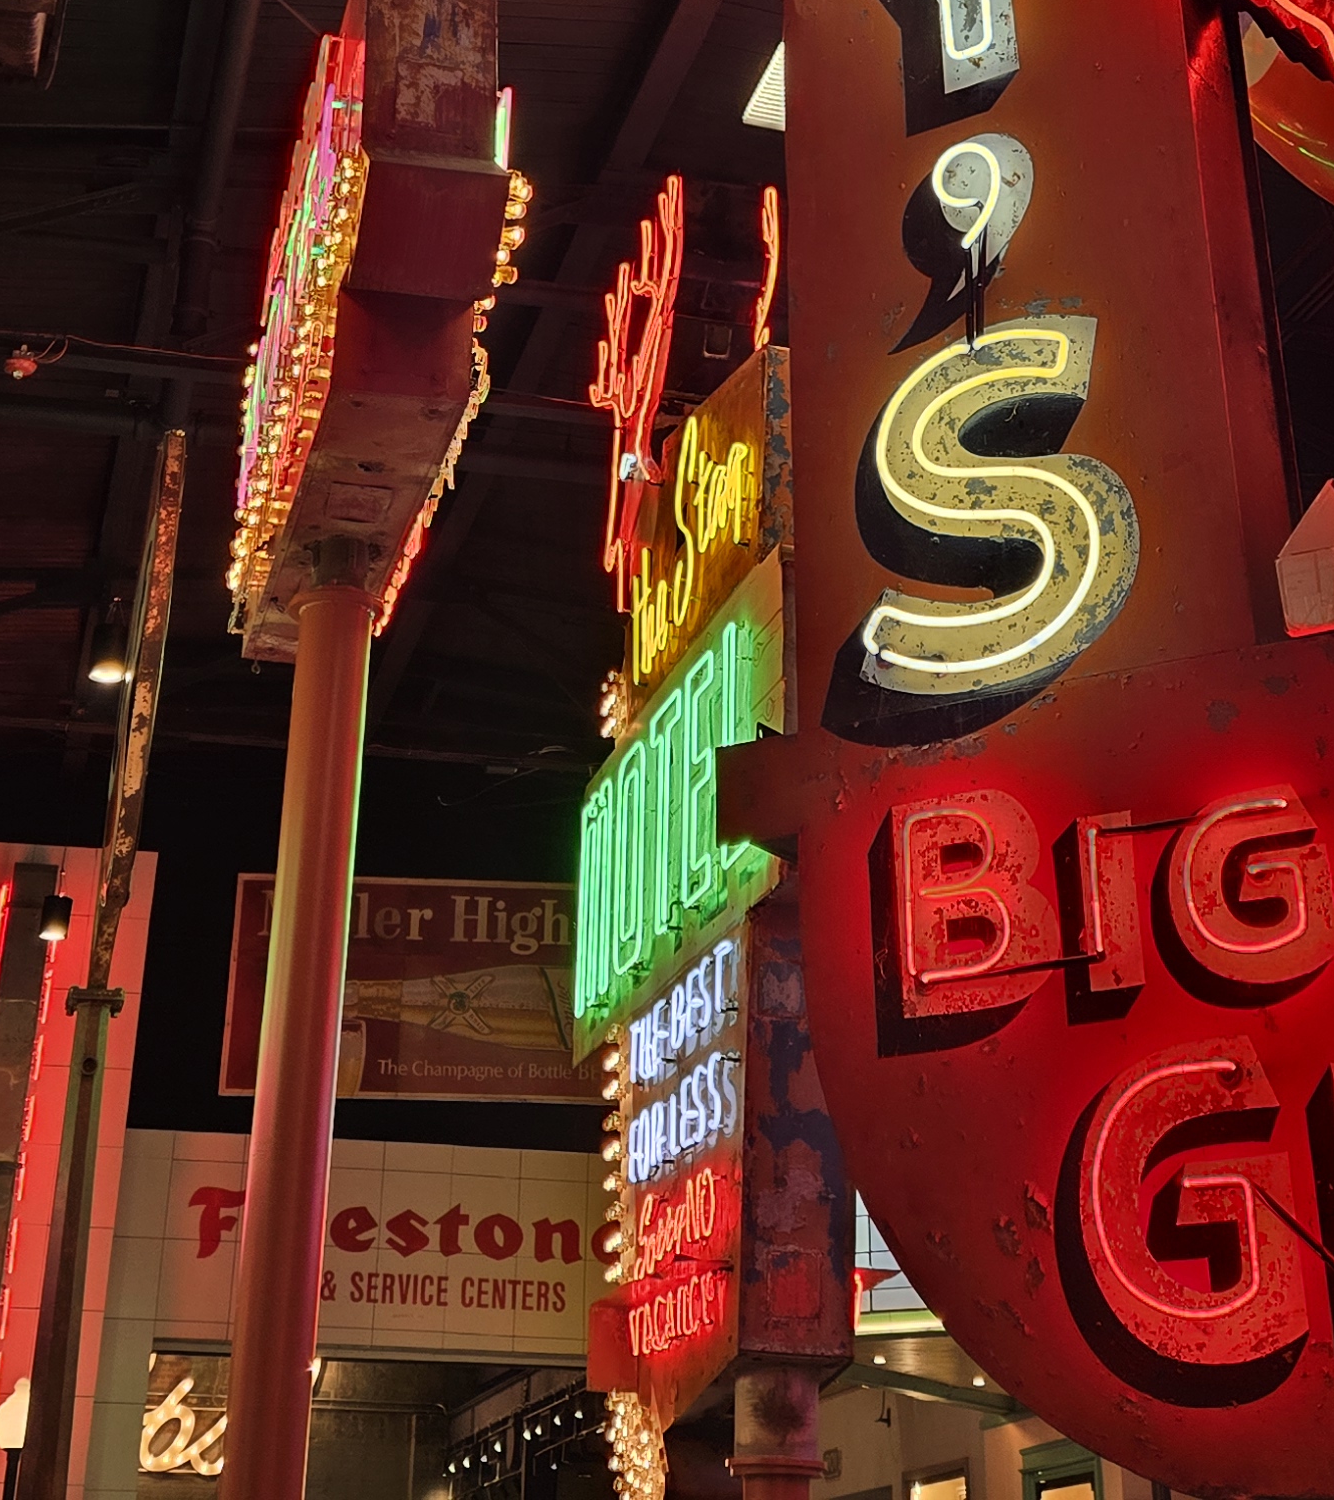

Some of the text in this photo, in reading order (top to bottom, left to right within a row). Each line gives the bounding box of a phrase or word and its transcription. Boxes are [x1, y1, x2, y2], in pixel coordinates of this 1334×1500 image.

[450, 894, 572, 956] High
[629, 999, 670, 1084] THE
[670, 939, 735, 1050] BEST
[377, 1058, 407, 1077] The
[412, 1059, 504, 1082] Champagne
[507, 1061, 525, 1079] of
[528, 1062, 572, 1081] Bottle
[669, 1051, 725, 1156] LESS
[188, 1186, 621, 1266] Feston
[685, 1167, 717, 1243] NO
[321, 1270, 566, 1313] & SERVICE CENTERS
[628, 1270, 728, 1357] VACANCY
